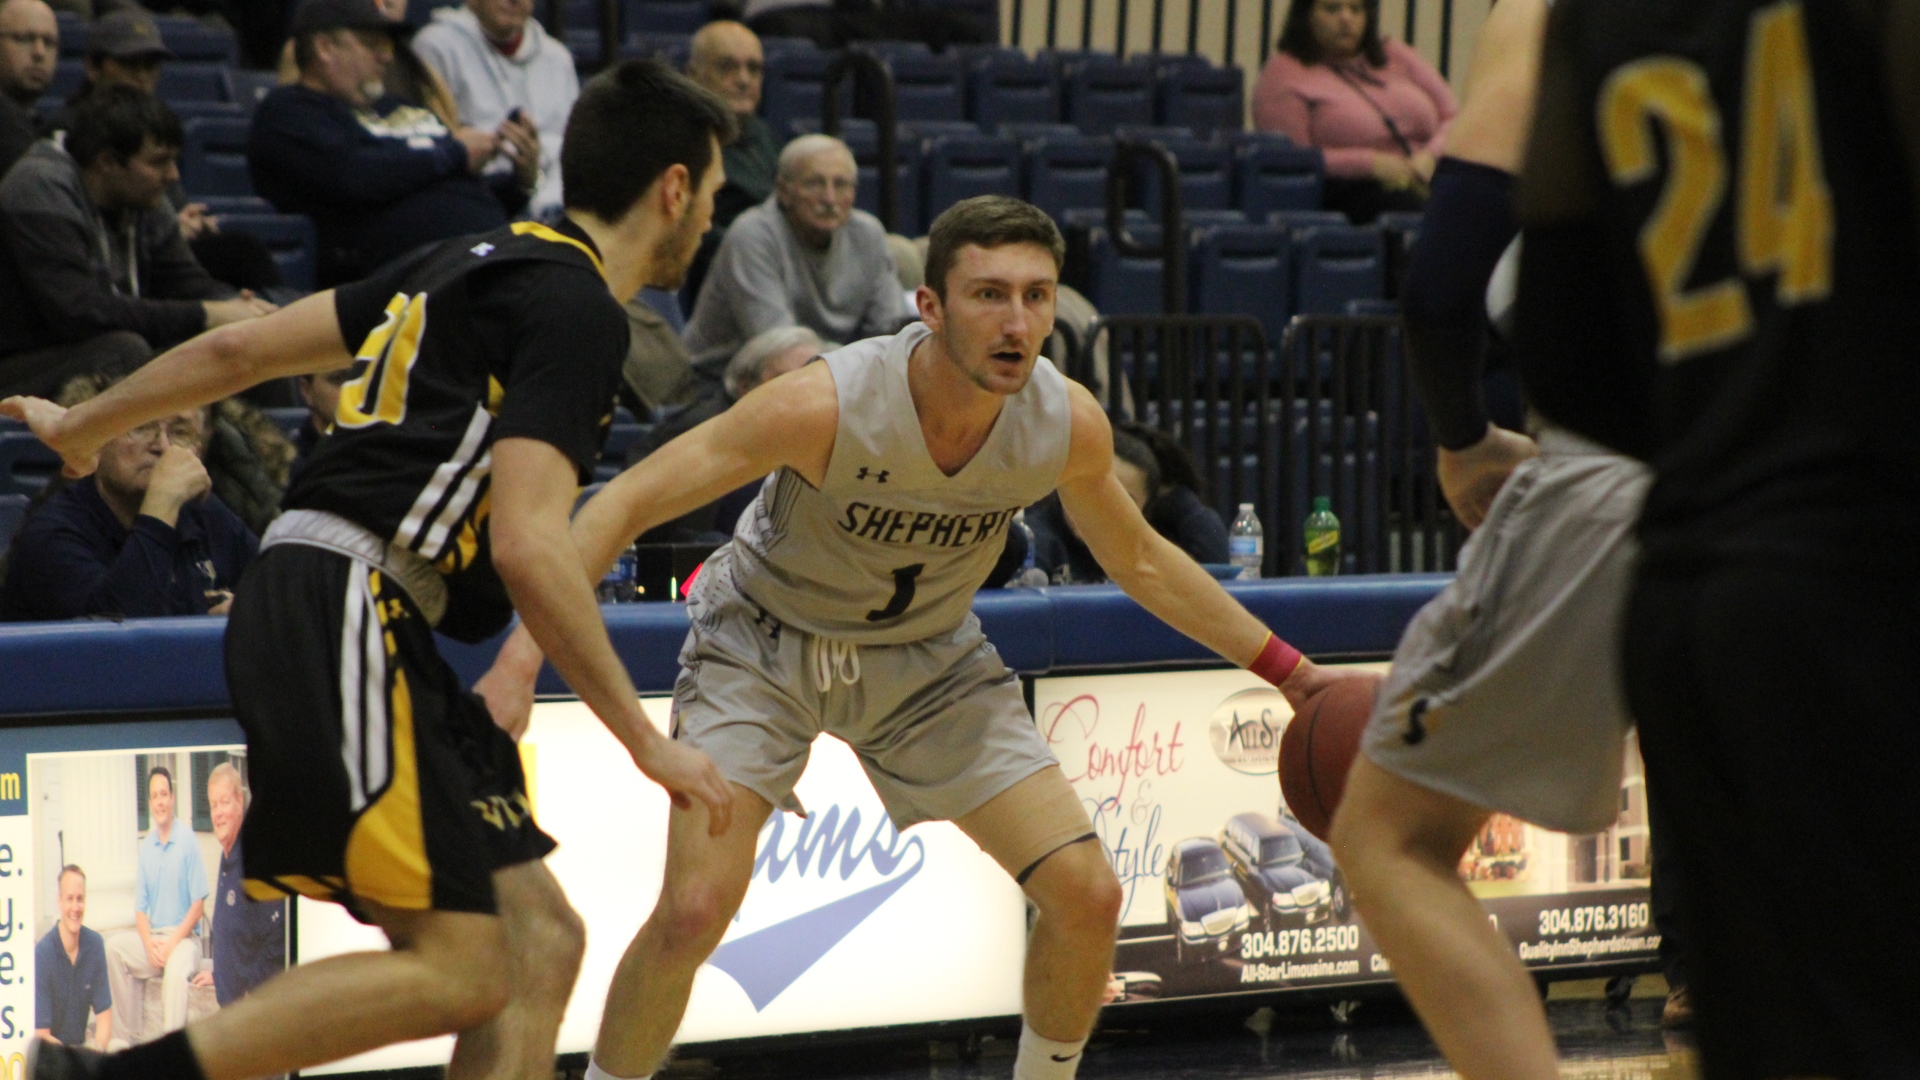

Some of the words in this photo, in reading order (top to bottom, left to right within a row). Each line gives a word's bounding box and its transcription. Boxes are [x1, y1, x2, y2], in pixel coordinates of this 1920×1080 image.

[1594, 3, 1836, 364] 24
[865, 563, 926, 622] 1
[1043, 694, 1184, 811] Comfort
[751, 803, 900, 884] ams
[1240, 924, 1359, 959] 304.876.2500
[1538, 902, 1650, 935] 304.876.3160
[1240, 958, 1360, 983] All-StarLimousine.com
